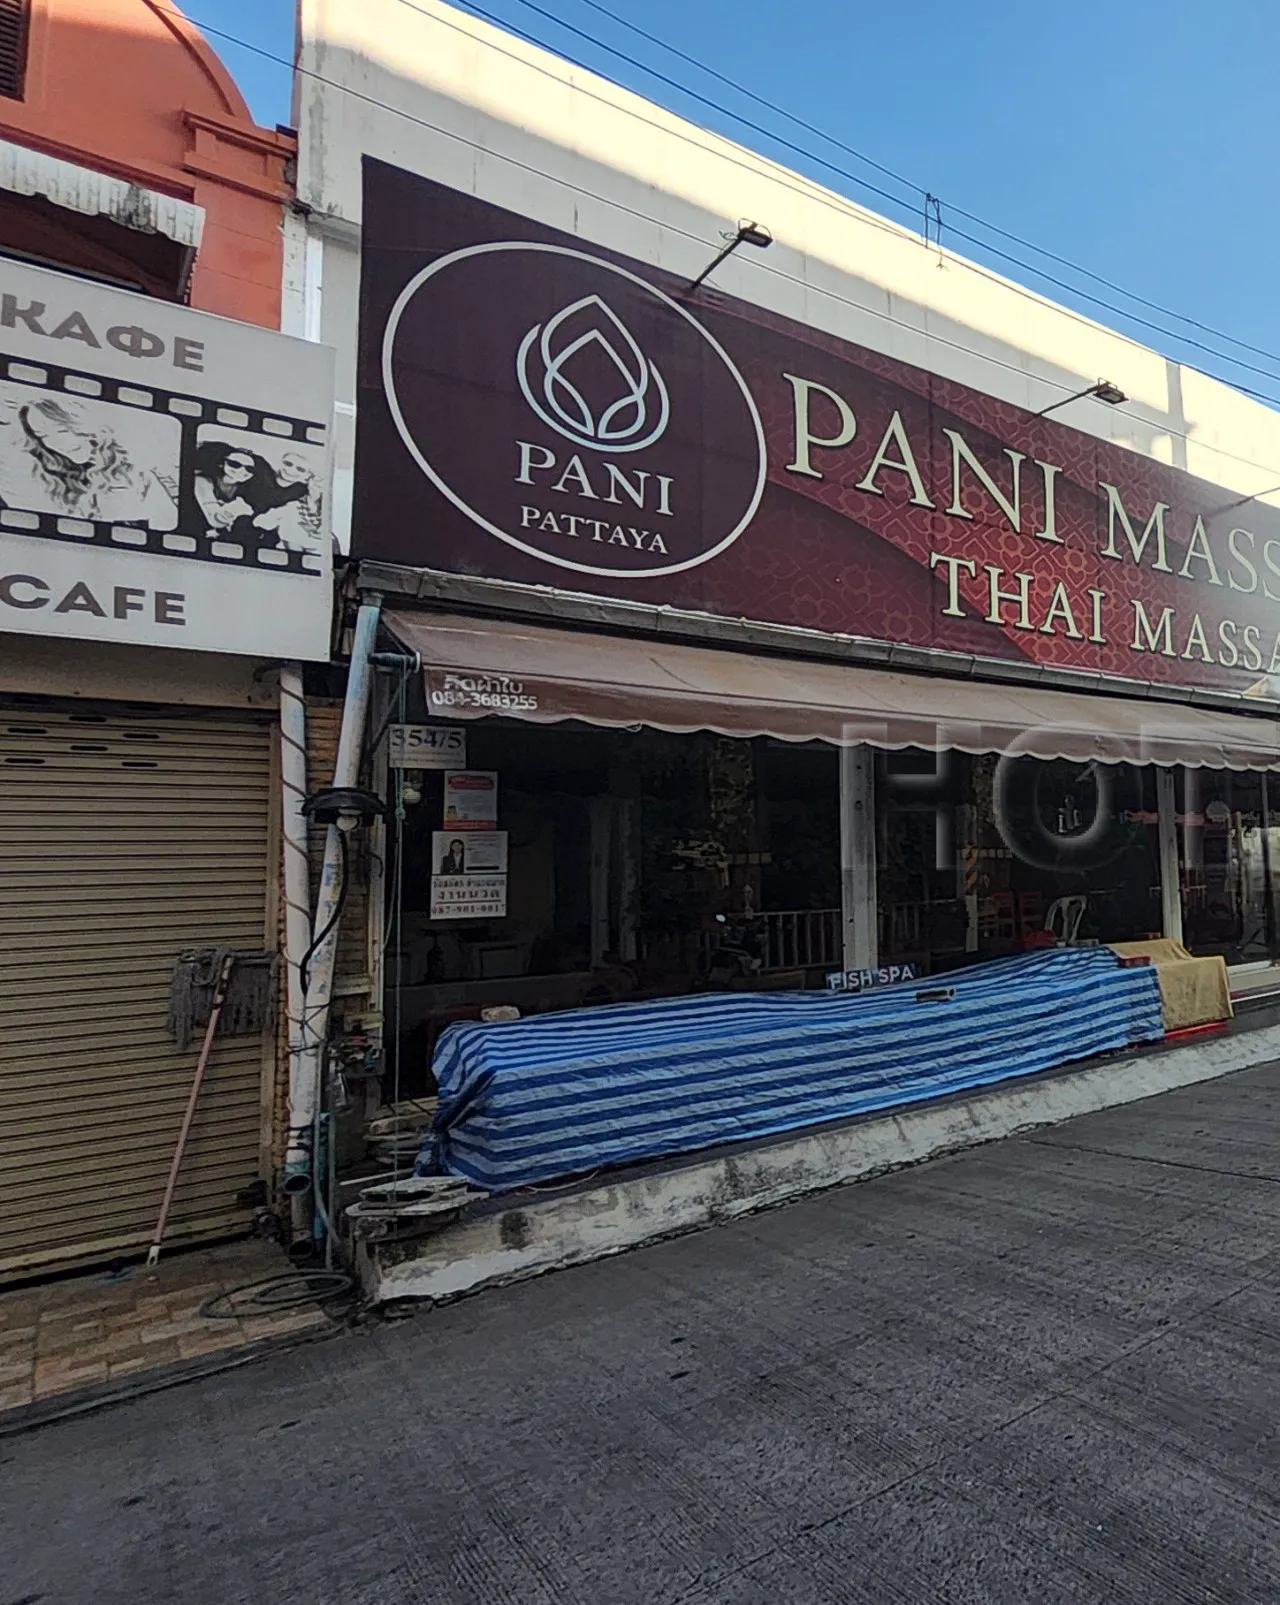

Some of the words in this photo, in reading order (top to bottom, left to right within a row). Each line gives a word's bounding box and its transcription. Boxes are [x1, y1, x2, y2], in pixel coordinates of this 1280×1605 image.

[0, 294, 205, 373] КАФЕ
[514, 440, 674, 517] PANI
[783, 372, 1064, 544] PANI
[520, 506, 669, 555] PATTAYA
[0, 573, 187, 626] CAFE
[930, 551, 1107, 644] THAI
[391, 727, 462, 749] 354/5
[828, 970, 874, 990] FISH
[878, 966, 914, 984] SPA
